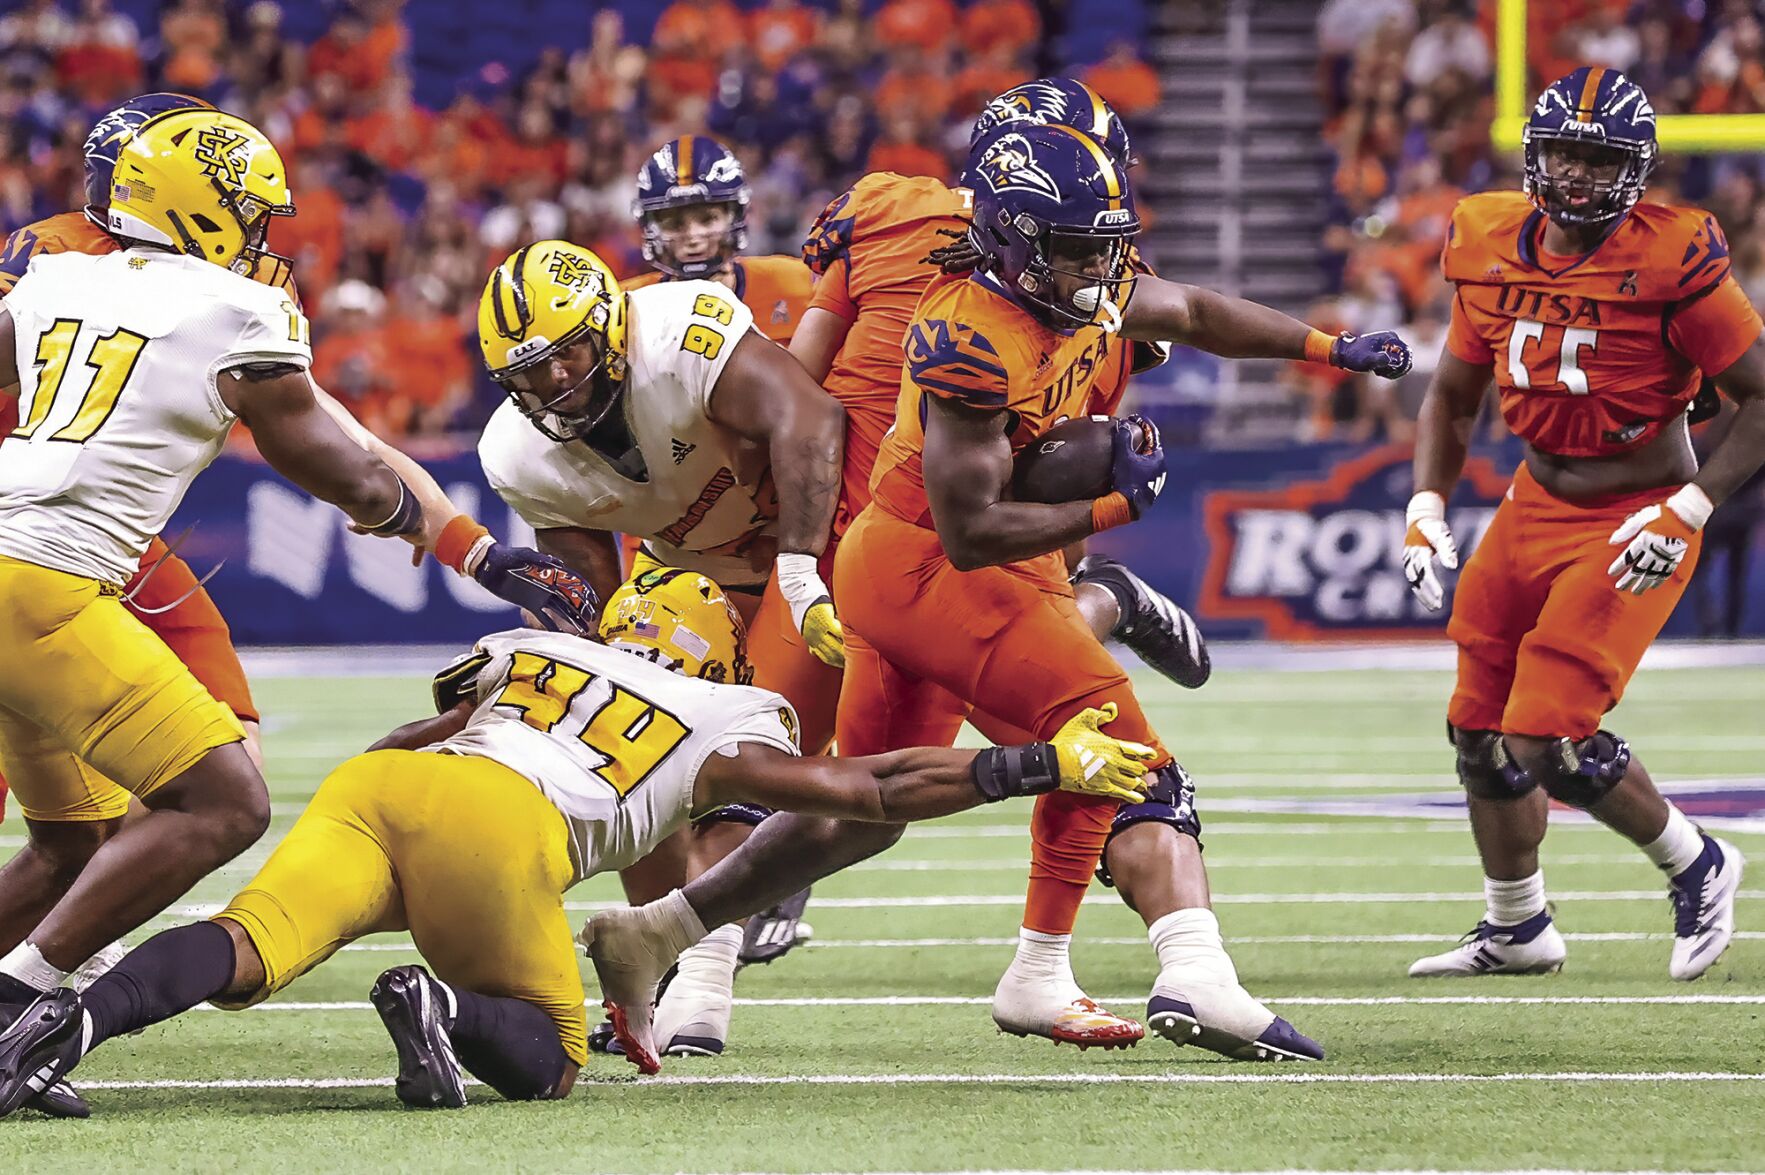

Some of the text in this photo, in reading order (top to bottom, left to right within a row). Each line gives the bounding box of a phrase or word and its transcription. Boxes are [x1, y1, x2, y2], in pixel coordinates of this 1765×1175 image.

[1105, 212, 1130, 224] UTSA
[679, 293, 735, 361] 99
[1496, 284, 1602, 327] UTSA
[9, 317, 151, 444] 11
[1041, 330, 1109, 417] UTSA
